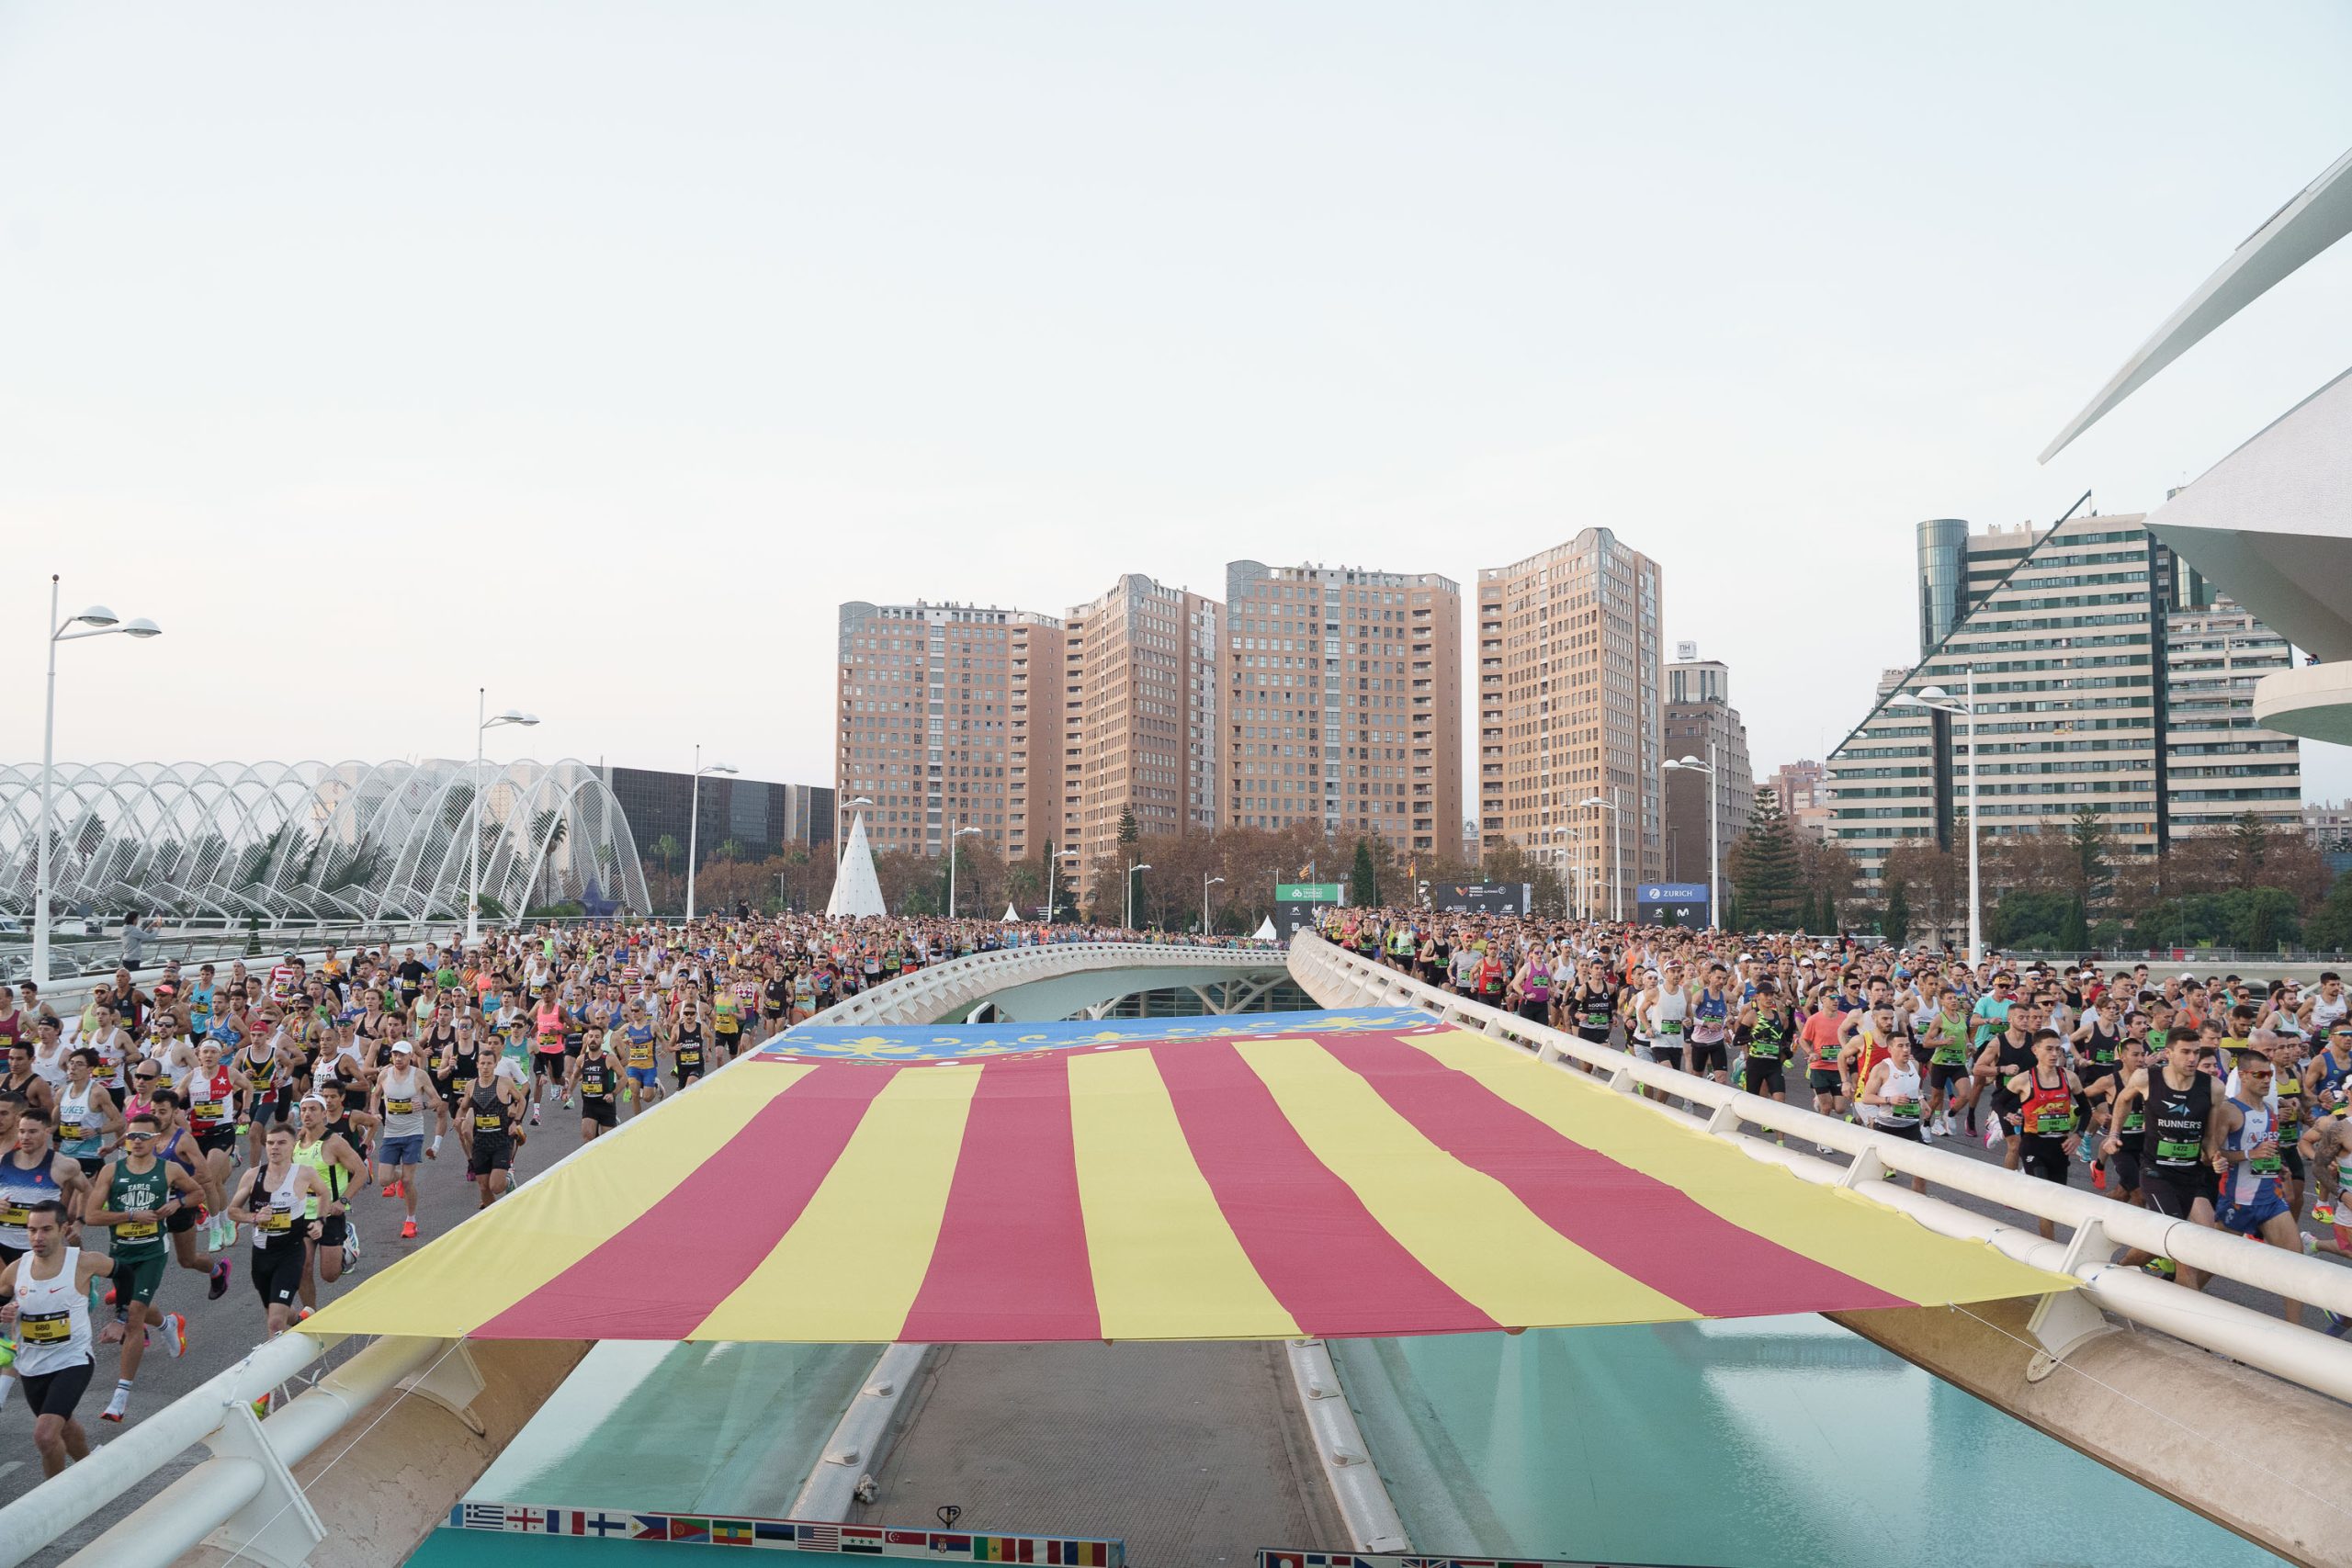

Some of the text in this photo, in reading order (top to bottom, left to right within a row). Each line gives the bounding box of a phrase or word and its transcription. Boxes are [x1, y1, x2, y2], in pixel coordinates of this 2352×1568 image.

[2157, 1118, 2202, 1129] RUNNER'S
[2246, 1131, 2279, 1144] ALPES
[128, 1183, 151, 1191] EARLS
[119, 1190, 156, 1206] RUN CLUB
